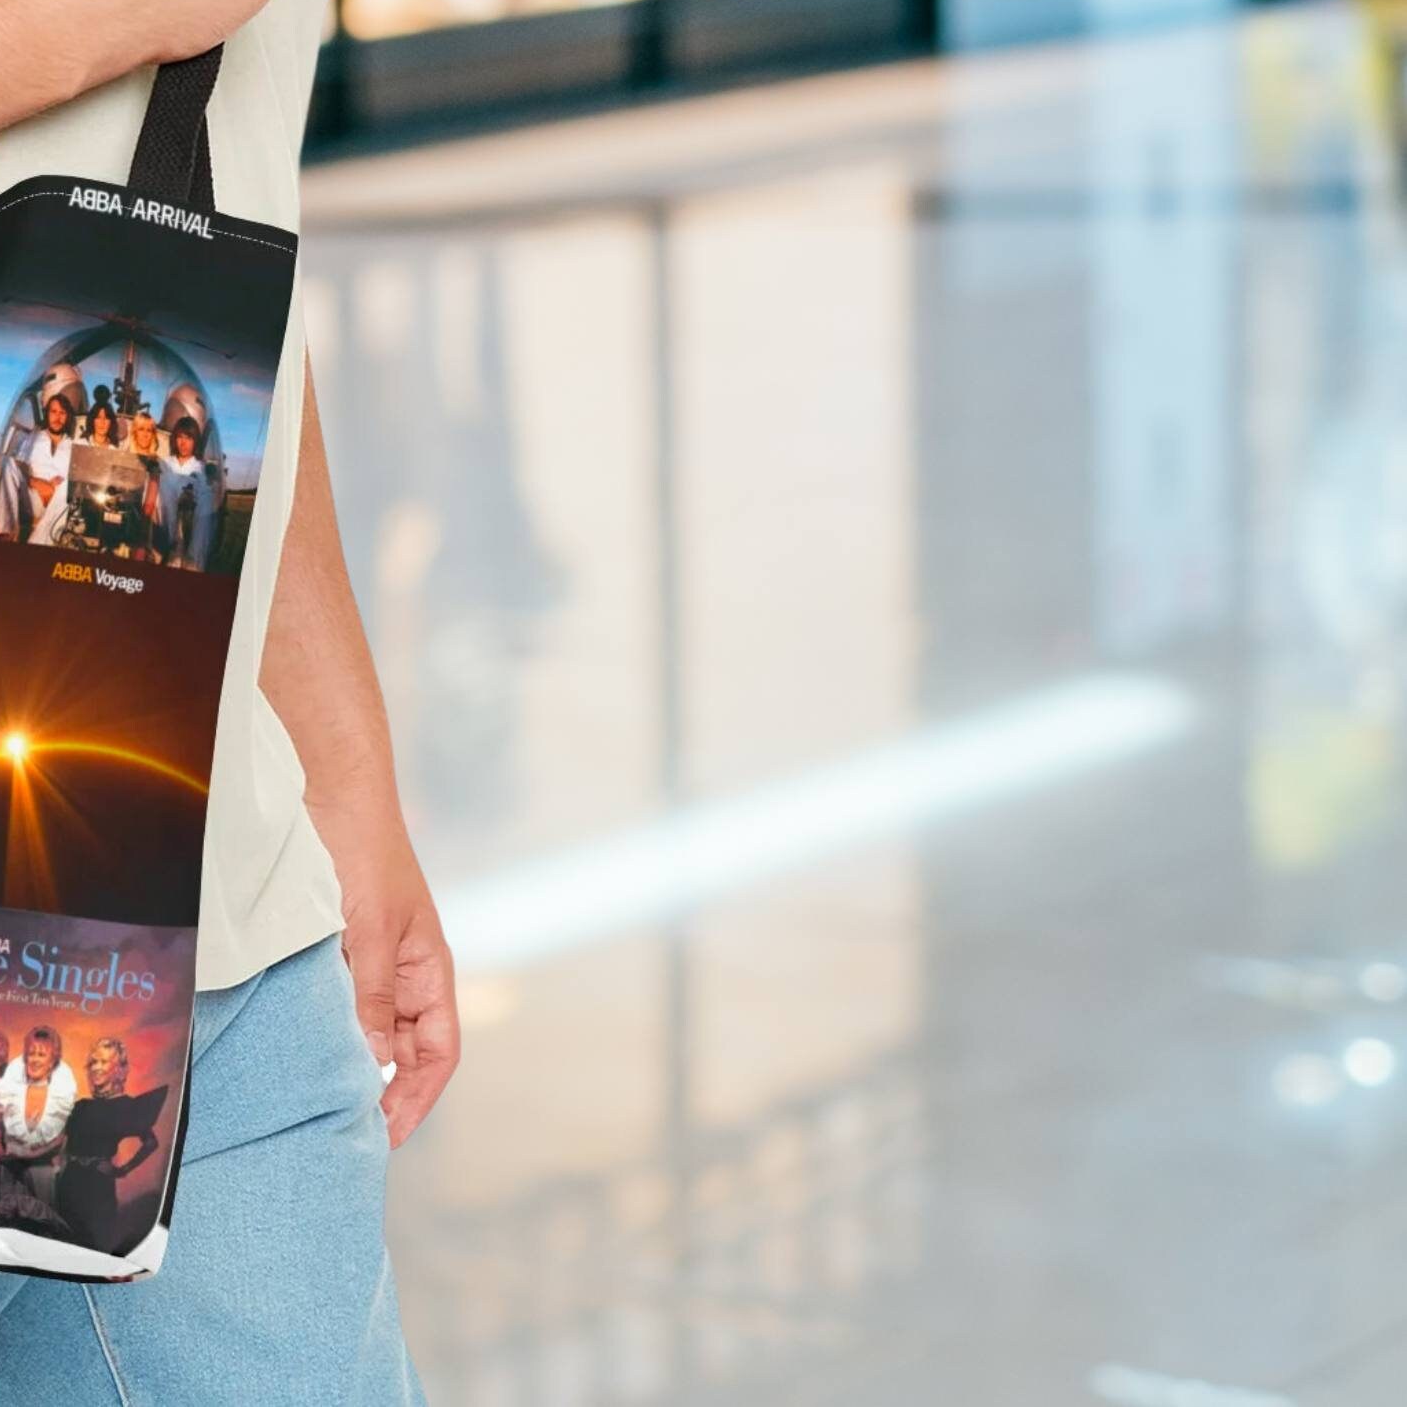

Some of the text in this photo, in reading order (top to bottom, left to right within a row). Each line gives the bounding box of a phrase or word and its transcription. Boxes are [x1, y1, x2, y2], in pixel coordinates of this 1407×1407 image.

[69, 186, 214, 240] ABBA ARRIVAL
[51, 562, 144, 594] ABBA Voyage
[17, 942, 156, 1014] Singles
